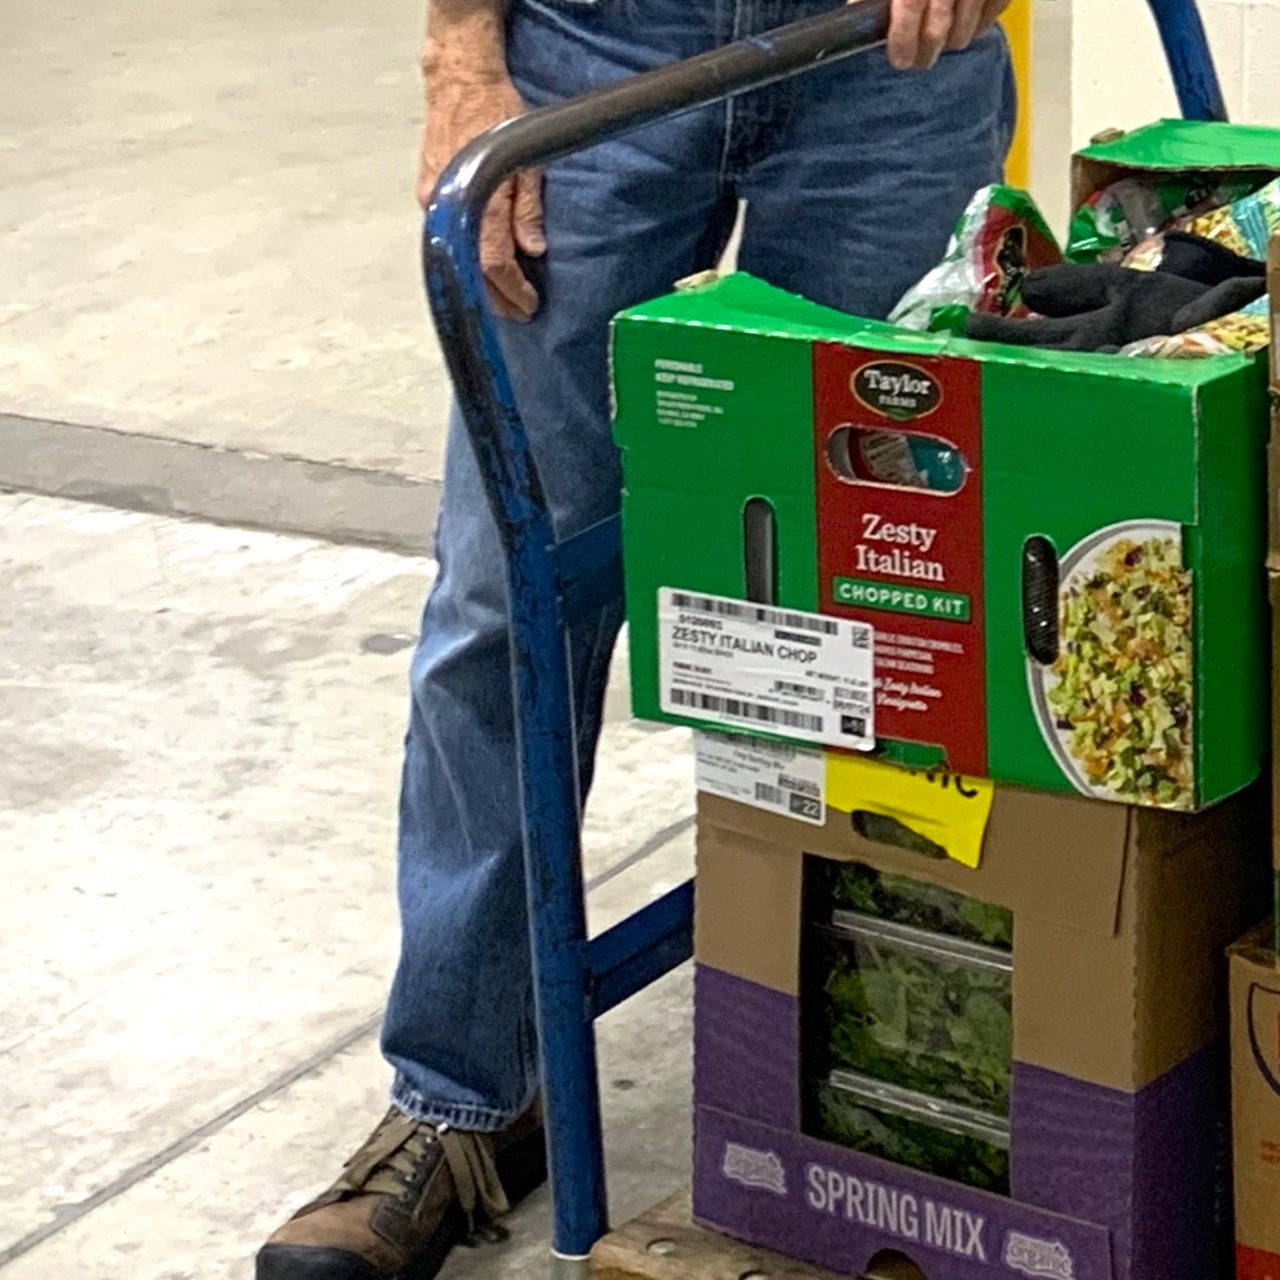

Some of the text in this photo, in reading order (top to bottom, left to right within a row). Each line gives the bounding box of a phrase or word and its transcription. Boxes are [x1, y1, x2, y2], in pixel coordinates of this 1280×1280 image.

[863, 369, 932, 396] Taylor
[878, 395, 917, 408] FARMS
[861, 512, 938, 552] Zesty
[854, 544, 945, 582] Italian
[838, 583, 964, 616] CHOPPED KIT
[672, 626, 718, 646] ZESTY
[719, 634, 775, 658] ITALIAN
[777, 645, 818, 665] CHOP
[802, 799, 820, 817] 22
[807, 1164, 987, 1262] SPRING MIX
